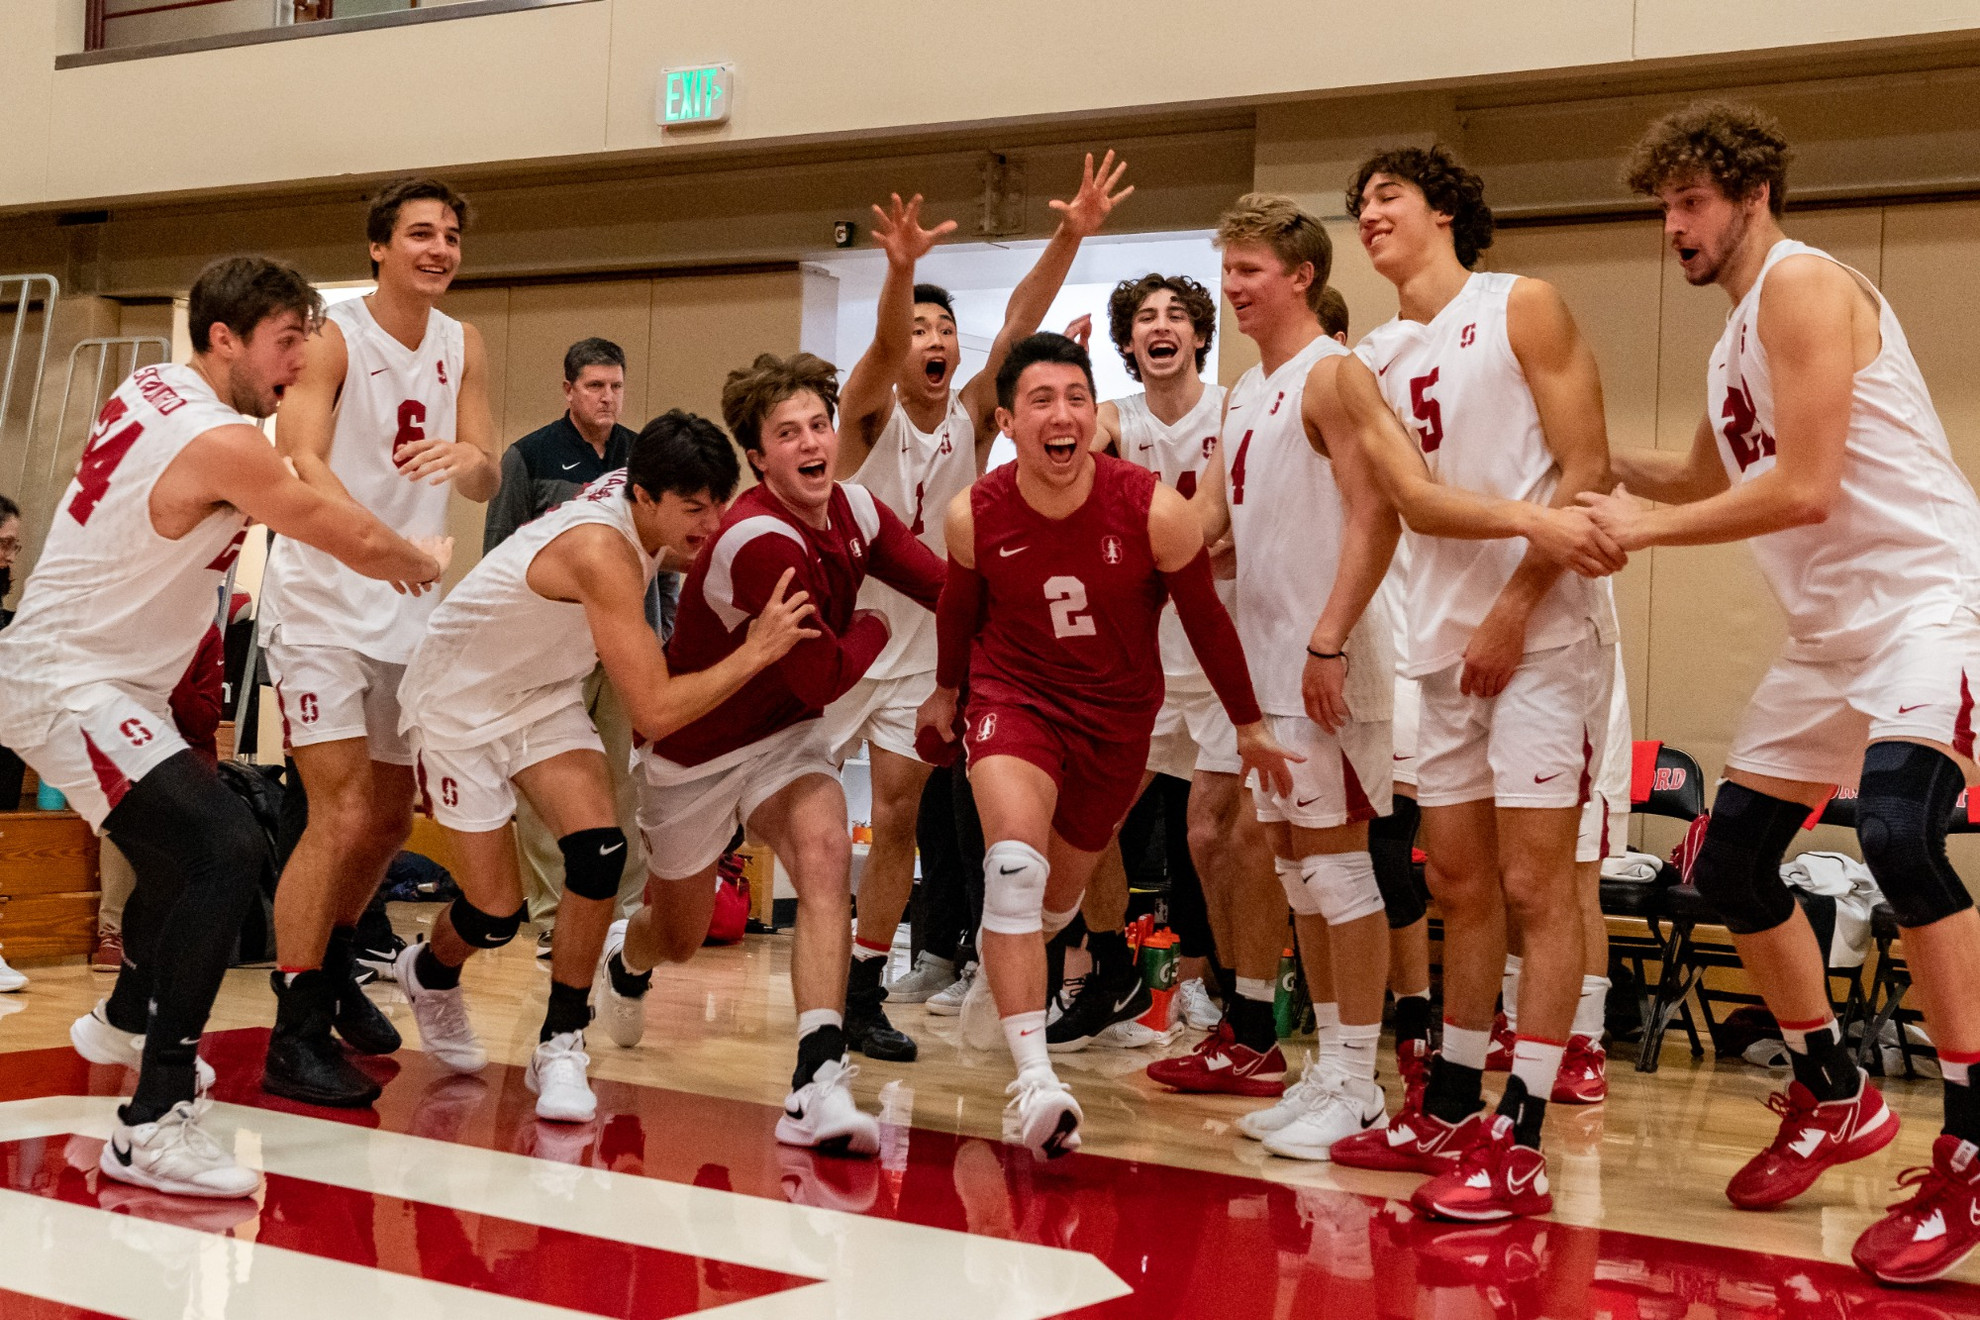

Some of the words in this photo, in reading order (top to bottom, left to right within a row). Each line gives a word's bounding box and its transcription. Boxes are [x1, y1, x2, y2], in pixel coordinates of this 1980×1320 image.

[665, 68, 718, 121] EXIT
[1409, 366, 1444, 454] 5
[1231, 429, 1254, 505] 4
[1043, 575, 1097, 639] 2
[1651, 767, 1687, 791] RD
